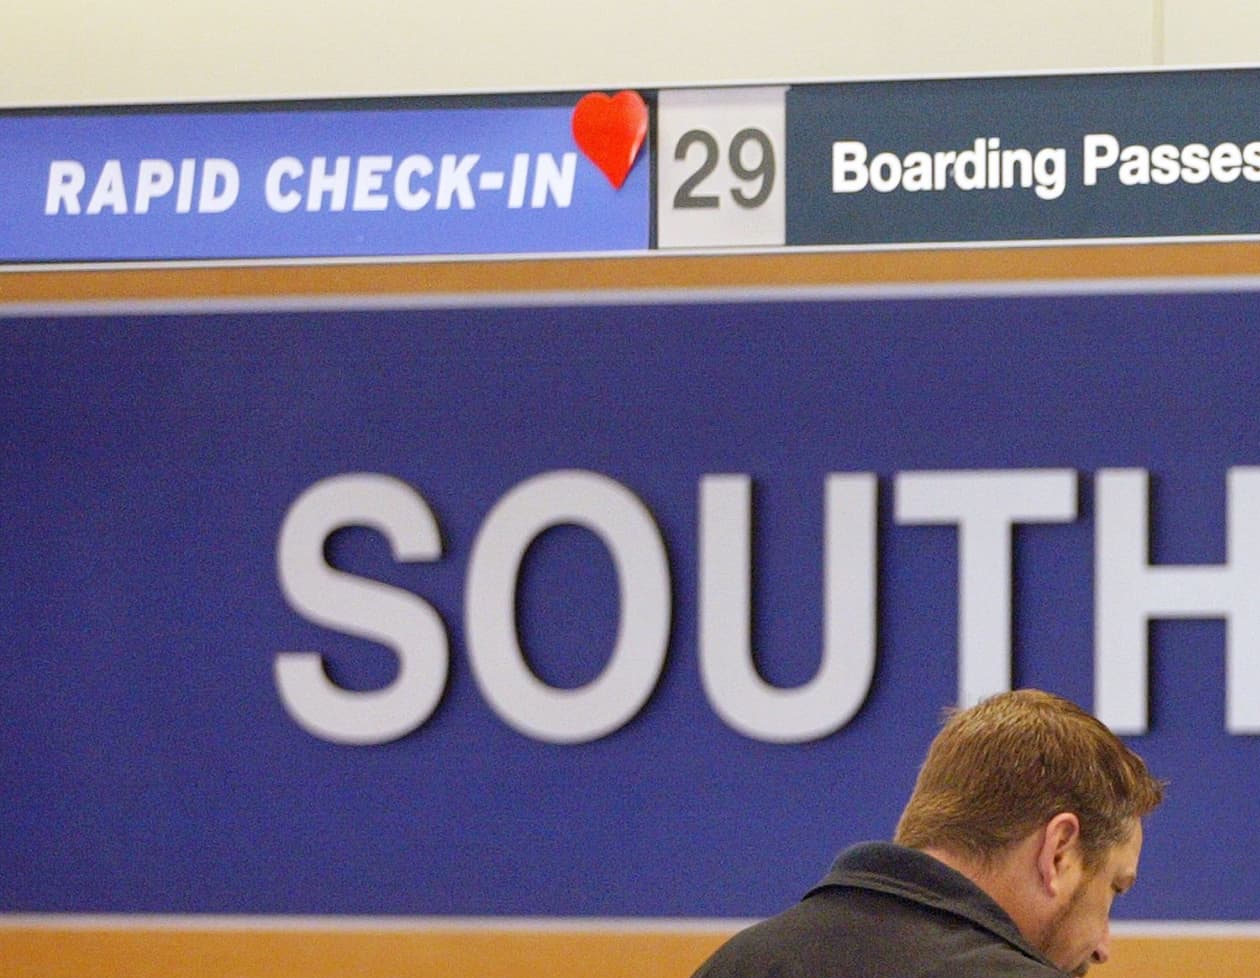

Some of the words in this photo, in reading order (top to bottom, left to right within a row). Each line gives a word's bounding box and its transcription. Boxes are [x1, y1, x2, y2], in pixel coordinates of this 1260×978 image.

[45, 158, 240, 215] RAPID
[264, 151, 578, 213] CHECK-IN
[673, 128, 776, 210] 29
[831, 137, 1067, 201] Boarding
